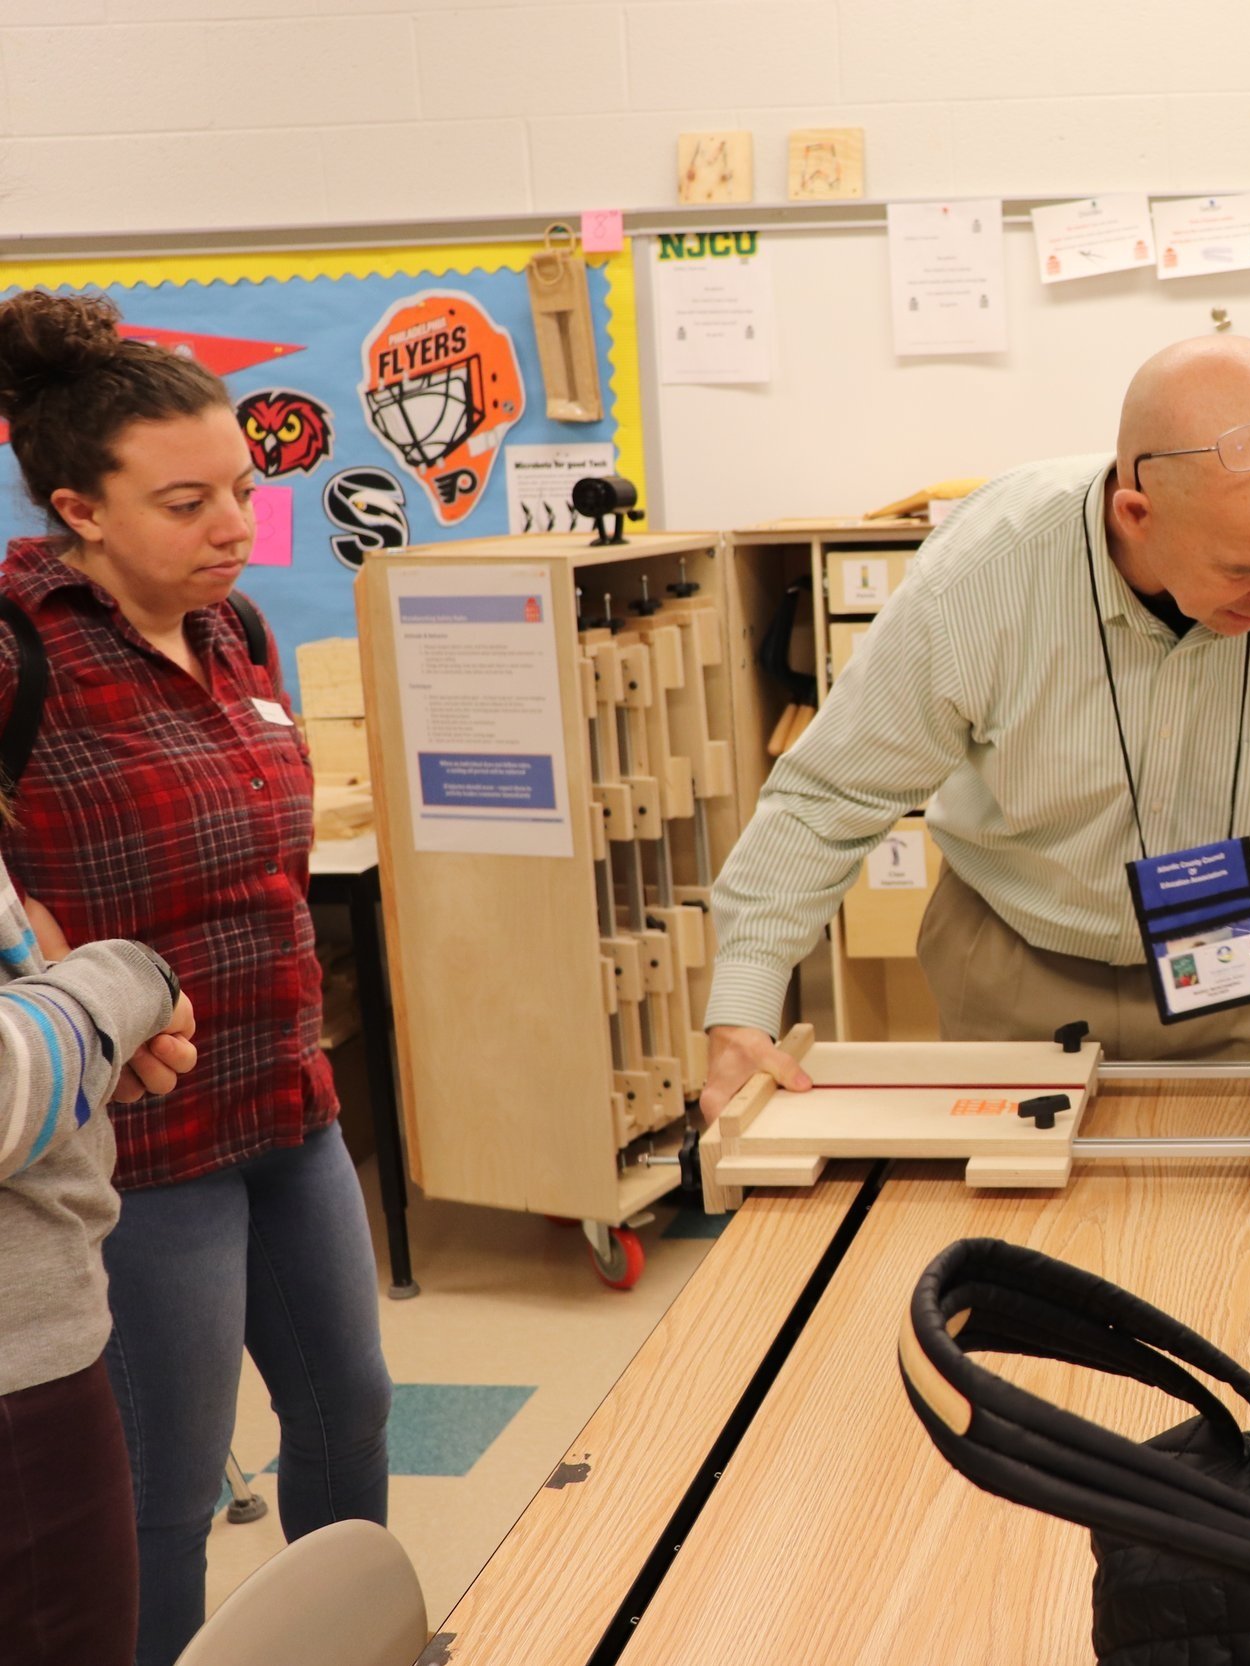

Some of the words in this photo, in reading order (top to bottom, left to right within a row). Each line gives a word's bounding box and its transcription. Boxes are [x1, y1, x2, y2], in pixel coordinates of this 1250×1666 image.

[657, 231, 761, 262] NJCU
[388, 317, 448, 346] PHILADELPHIA
[378, 326, 468, 380] FLYERS
